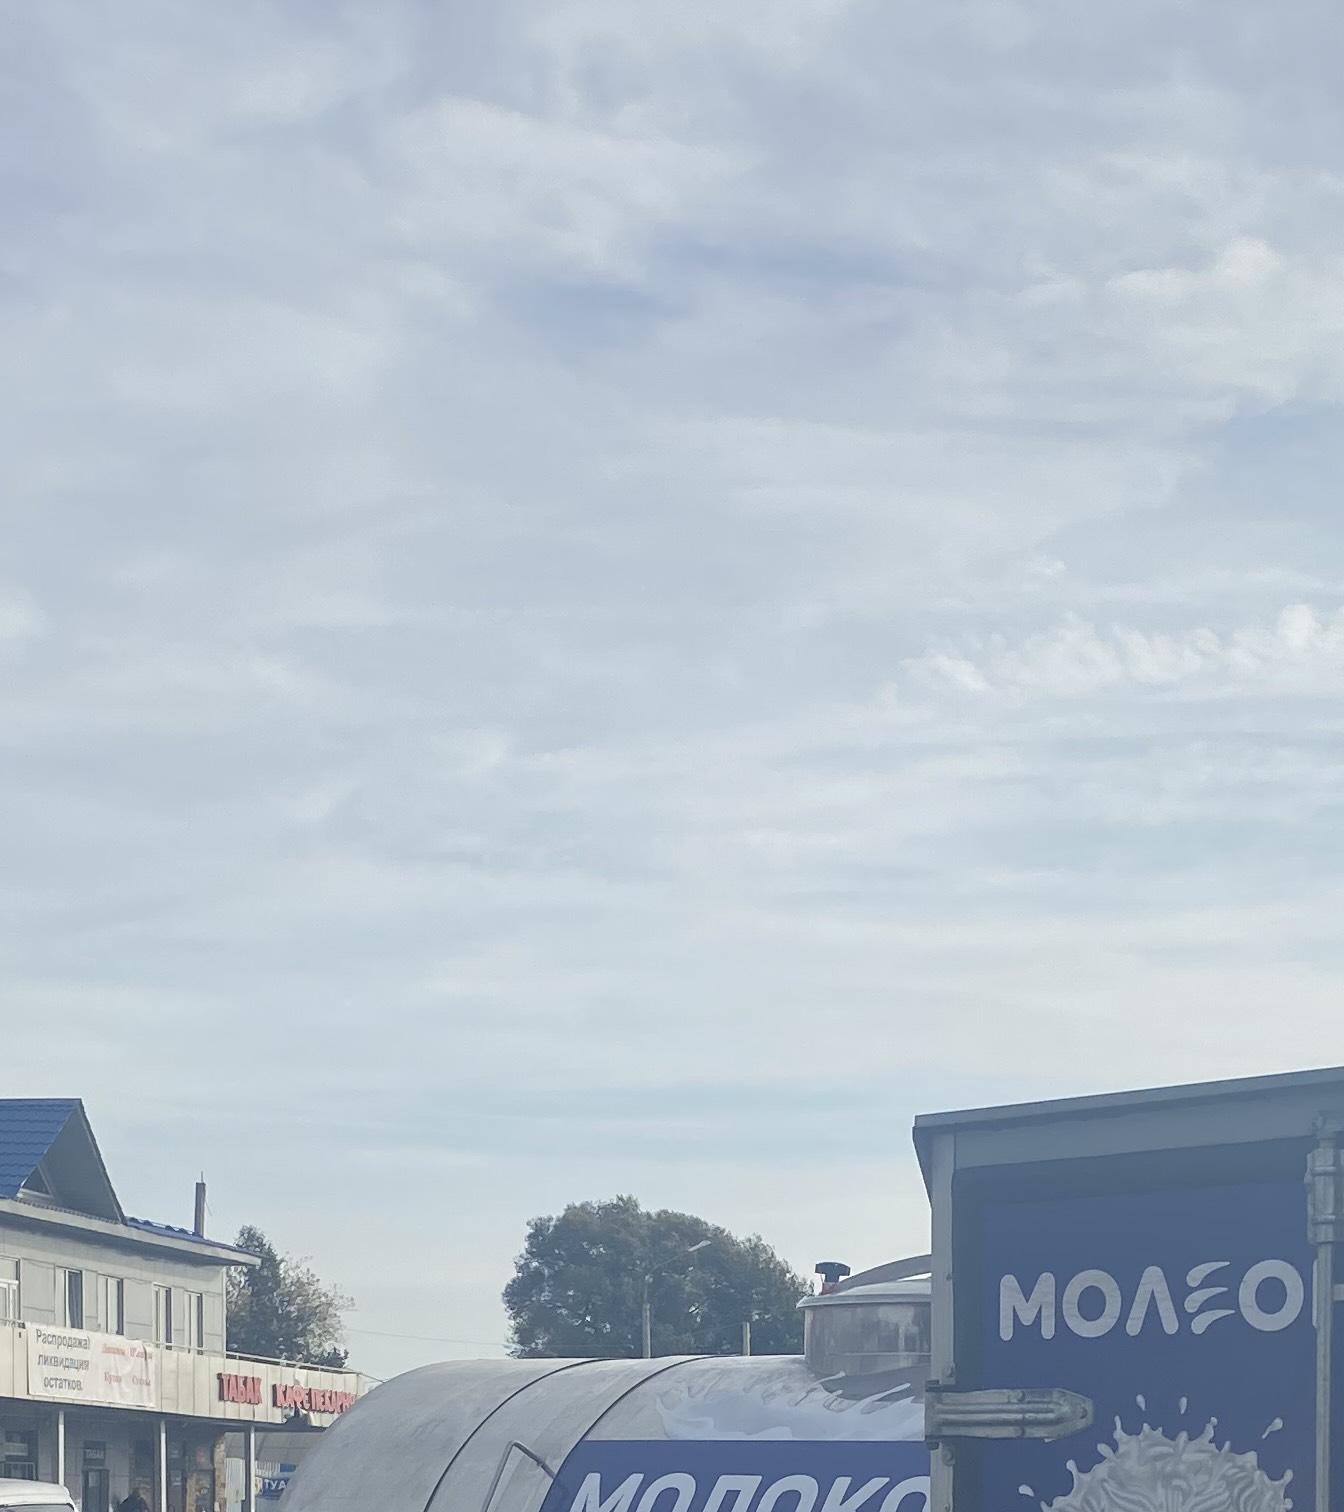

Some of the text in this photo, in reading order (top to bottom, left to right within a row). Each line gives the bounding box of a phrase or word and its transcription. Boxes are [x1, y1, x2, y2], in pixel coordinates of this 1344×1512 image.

[35, 1328, 91, 1350] Распродажа!
[37, 1354, 90, 1371] ликвидация
[43, 1376, 84, 1391] остатков.
[220, 1373, 263, 1404] ТАБАК
[263, 1478, 288, 1490] ТУА
